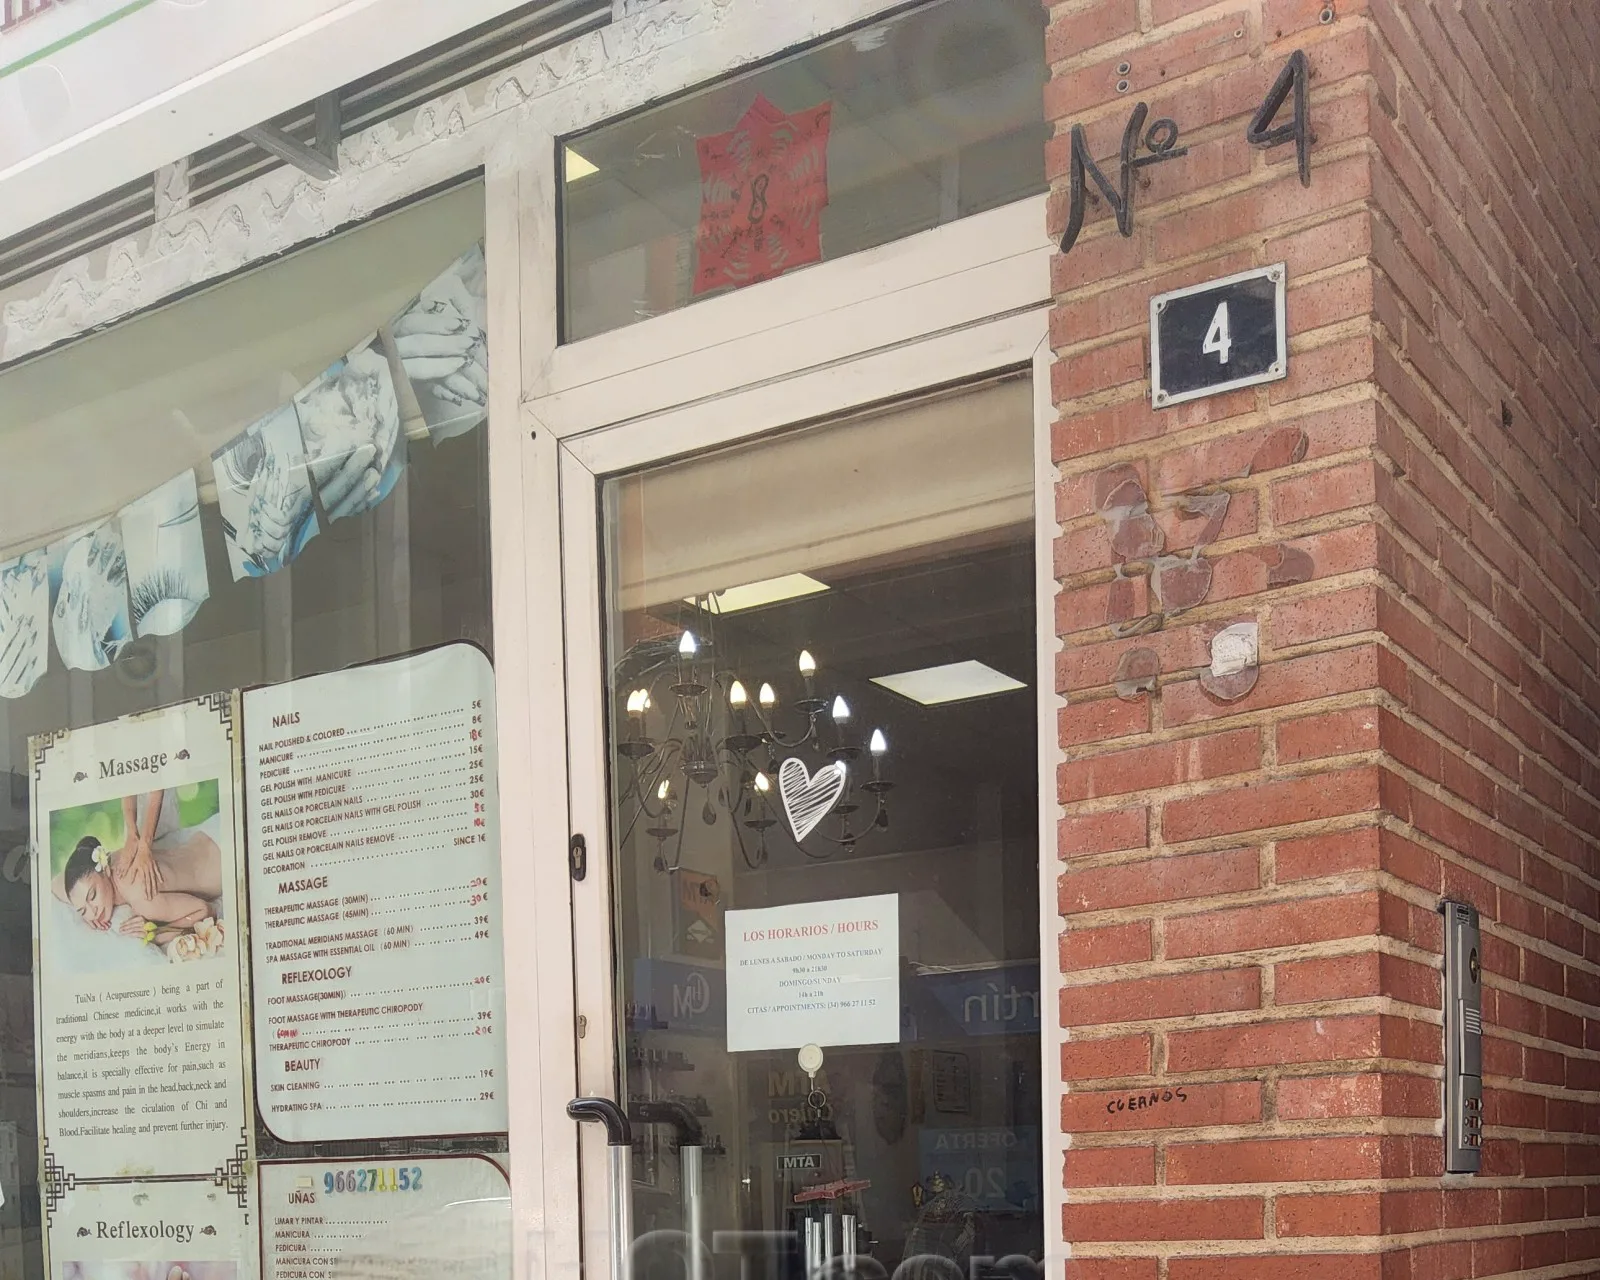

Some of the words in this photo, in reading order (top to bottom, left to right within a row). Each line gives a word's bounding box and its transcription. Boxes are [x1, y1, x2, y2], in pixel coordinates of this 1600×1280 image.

[1247, 50, 1317, 187] 4
[1201, 301, 1232, 364] 4
[258, 742, 273, 752] NAIL
[274, 736, 305, 748] POLISHED
[312, 727, 345, 741] COLORED
[471, 699, 481, 709] 5€
[271, 711, 300, 728] NAILS
[258, 751, 293, 765] MANICURE
[471, 713, 482, 724] 8€
[99, 753, 167, 778] Massage
[259, 783, 272, 793] GEL
[272, 779, 296, 790] POLISH
[296, 776, 313, 786] WITH
[315, 768, 351, 782] MANICURE
[469, 743, 483, 754] 15€
[260, 797, 273, 807] GEL
[273, 793, 296, 804] POLISH
[296, 789, 313, 800] WITH
[313, 784, 346, 796] PEDICURE
[468, 758, 483, 769] 25€
[260, 811, 273, 820] GEL
[273, 807, 293, 818] NAILS
[293, 805, 304, 814] OR
[304, 799, 342, 812] PORCELAIN
[343, 795, 363, 806] NAILS
[469, 773, 483, 784] 25€
[262, 861, 305, 874] DECORATION
[453, 834, 475, 846] SINCE
[477, 832, 486, 842] 1€
[277, 876, 328, 893] MASSAGE
[264, 916, 305, 928] THERAPEUTIC
[306, 911, 339, 923] MASSAGE
[743, 930, 765, 942] LOS
[767, 924, 828, 939] HORARIOS
[837, 919, 878, 933] HOURS
[749, 957, 770, 965] LUNES
[775, 954, 802, 963] SABADO
[805, 951, 835, 960] MONDAY
[835, 950, 846, 958] TO
[846, 947, 883, 957] SATURDAY
[281, 966, 351, 984] REFLEXOLOGY
[55, 1012, 89, 1024] traditional
[92, 1010, 120, 1021] Chinese
[123, 1005, 161, 1018] medicine,it
[165, 1002, 187, 1013] works
[192, 1000, 208, 1011] with
[212, 999, 224, 1009] the
[267, 1015, 286, 1024] FOOT
[286, 1012, 319, 1023] MASSAGE
[319, 1010, 336, 1020] WITH
[336, 1006, 380, 1018] THERAPEUTIC
[380, 1002, 423, 1014] CHIROPODY
[746, 1005, 768, 1014] CITAS
[771, 1002, 826, 1012] APPOINTMENTS:
[826, 1001, 839, 1009] (34)
[839, 1000, 851, 1008] 966
[851, 999, 859, 1007] 27
[860, 999, 867, 1007] 11
[868, 998, 876, 1008] 52
[284, 1058, 320, 1072] BEAUTY
[270, 1083, 285, 1092] SKIN
[285, 1081, 320, 1091] CLEANING
[479, 1068, 494, 1078] 19€
[57, 1107, 119, 1118] shoulders,increase
[123, 1104, 136, 1114] the
[140, 1102, 175, 1113] ciculation
[180, 1100, 189, 1111] of
[194, 1099, 208, 1110] Chi
[214, 1098, 228, 1109] and
[270, 1103, 308, 1112] HYDRATING
[309, 1102, 322, 1110] SPA
[479, 1091, 494, 1100] 29€
[58, 1125, 110, 1136] Blood.Facilitate
[111, 1124, 137, 1135] healing
[138, 1122, 151, 1133] and
[152, 1123, 178, 1134] prevent
[179, 1120, 204, 1130] further
[205, 1119, 228, 1131] injury.
[323, 1167, 422, 1194] 966271152
[287, 1190, 315, 1204] UÑAS
[96, 1220, 194, 1242] Reflexology
[274, 1217, 294, 1225] LIMAR
[300, 1216, 324, 1224] PINTAR
[274, 1230, 310, 1238] MANICURA
